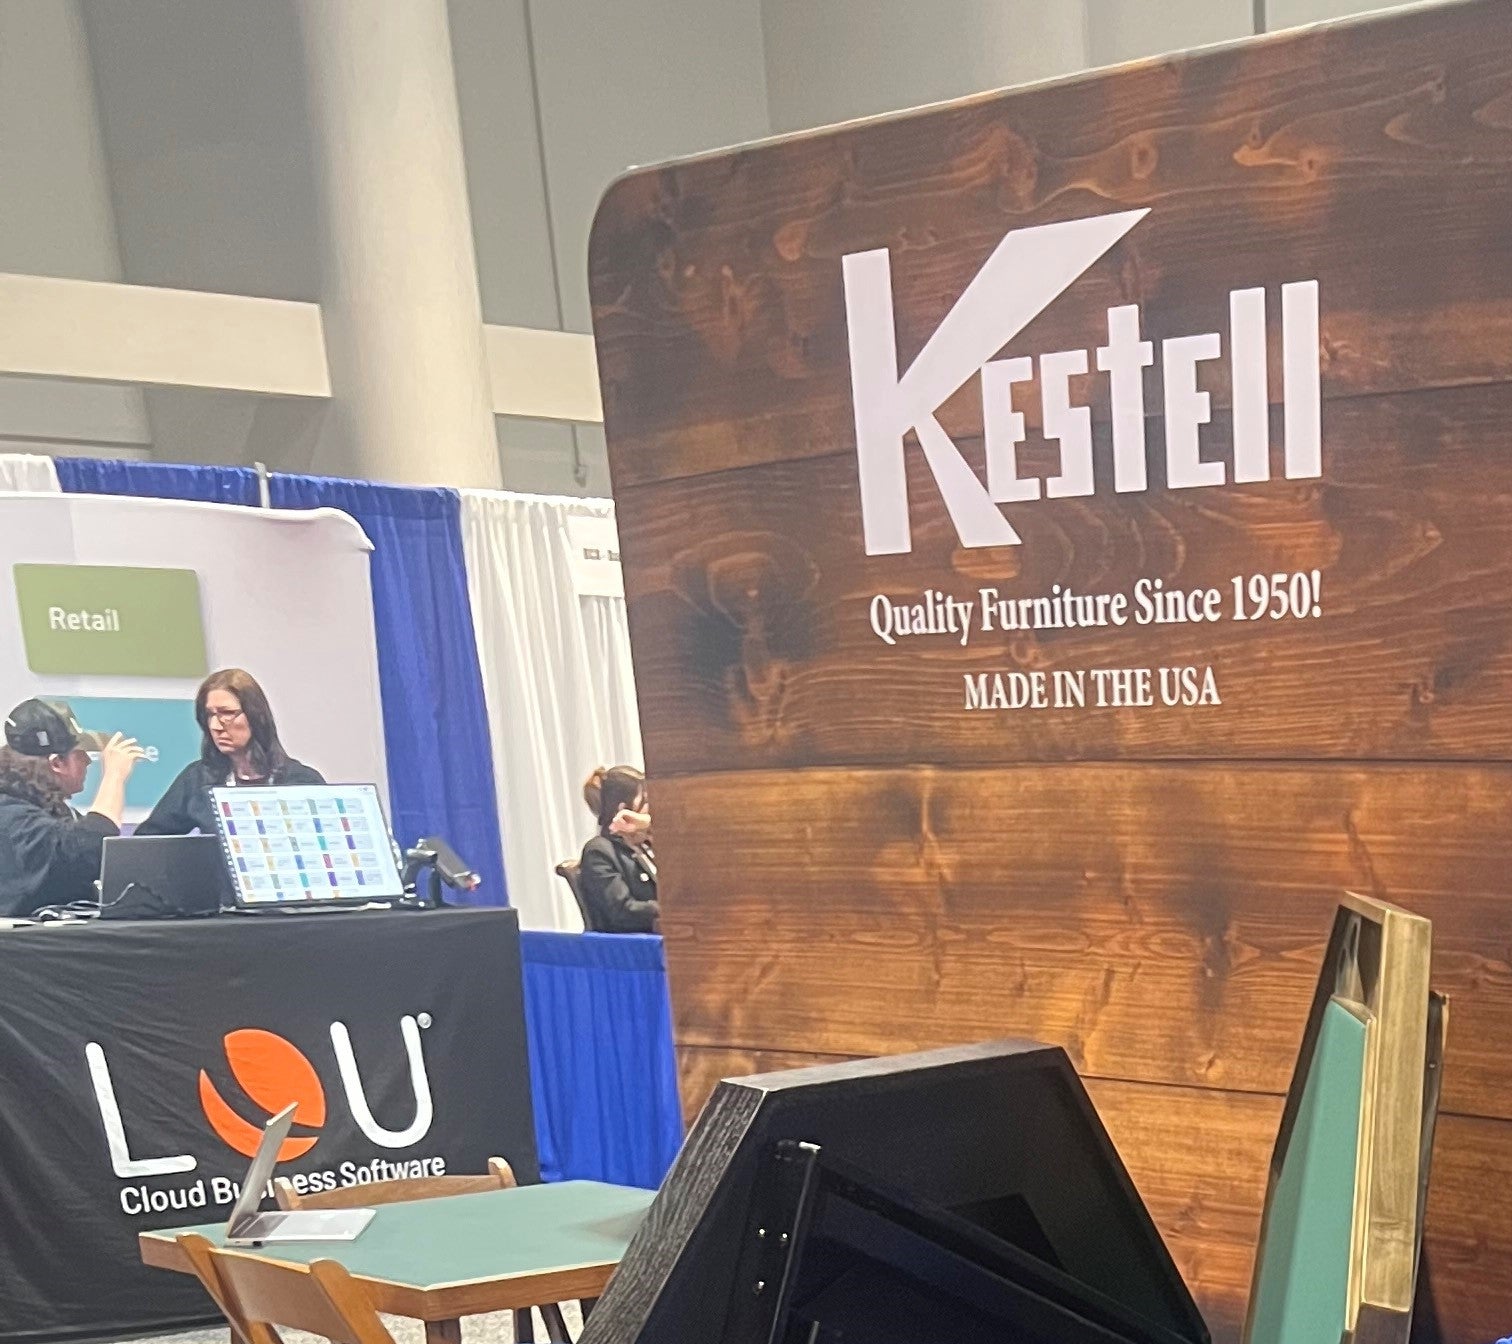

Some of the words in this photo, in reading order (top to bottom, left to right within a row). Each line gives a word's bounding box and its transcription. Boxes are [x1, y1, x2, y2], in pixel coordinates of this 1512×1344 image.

[49, 606, 120, 632] Retail
[869, 589, 974, 646] Quality
[978, 584, 1126, 632] Furniture
[1134, 578, 1222, 626] Since
[1230, 569, 1323, 621] 1950!
[963, 670, 1049, 710] MADE
[1053, 669, 1086, 708] IN
[1090, 668, 1153, 707] THE
[1158, 665, 1222, 706] USA
[119, 1179, 206, 1215] Cloud
[339, 1156, 446, 1188] Software
